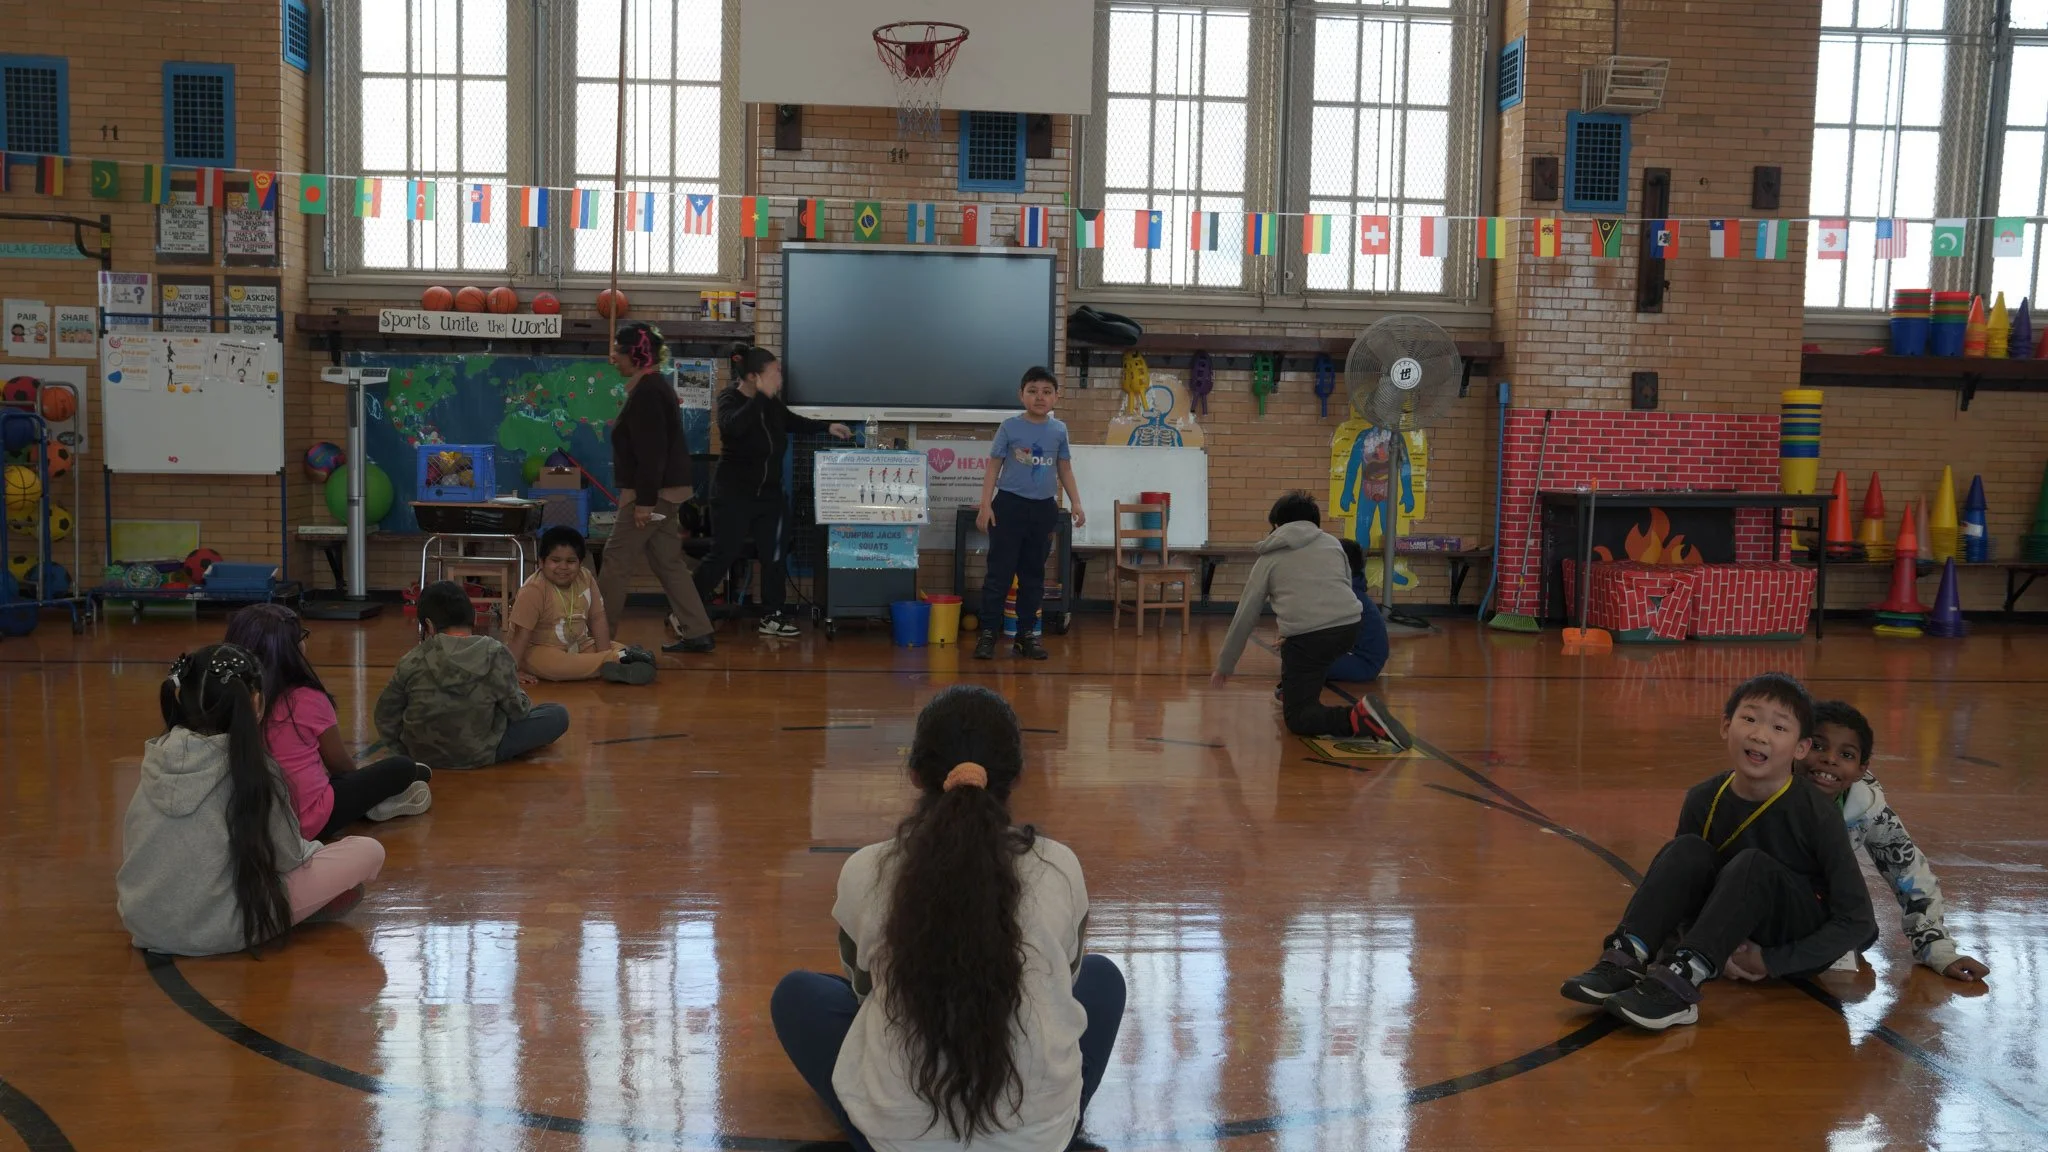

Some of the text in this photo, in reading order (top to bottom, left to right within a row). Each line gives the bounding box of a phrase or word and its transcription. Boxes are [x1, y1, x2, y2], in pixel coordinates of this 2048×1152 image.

[17, 313, 38, 321] PAIR
[61, 313, 89, 321] SHARE
[381, 311, 558, 335] Sports Unite the World
